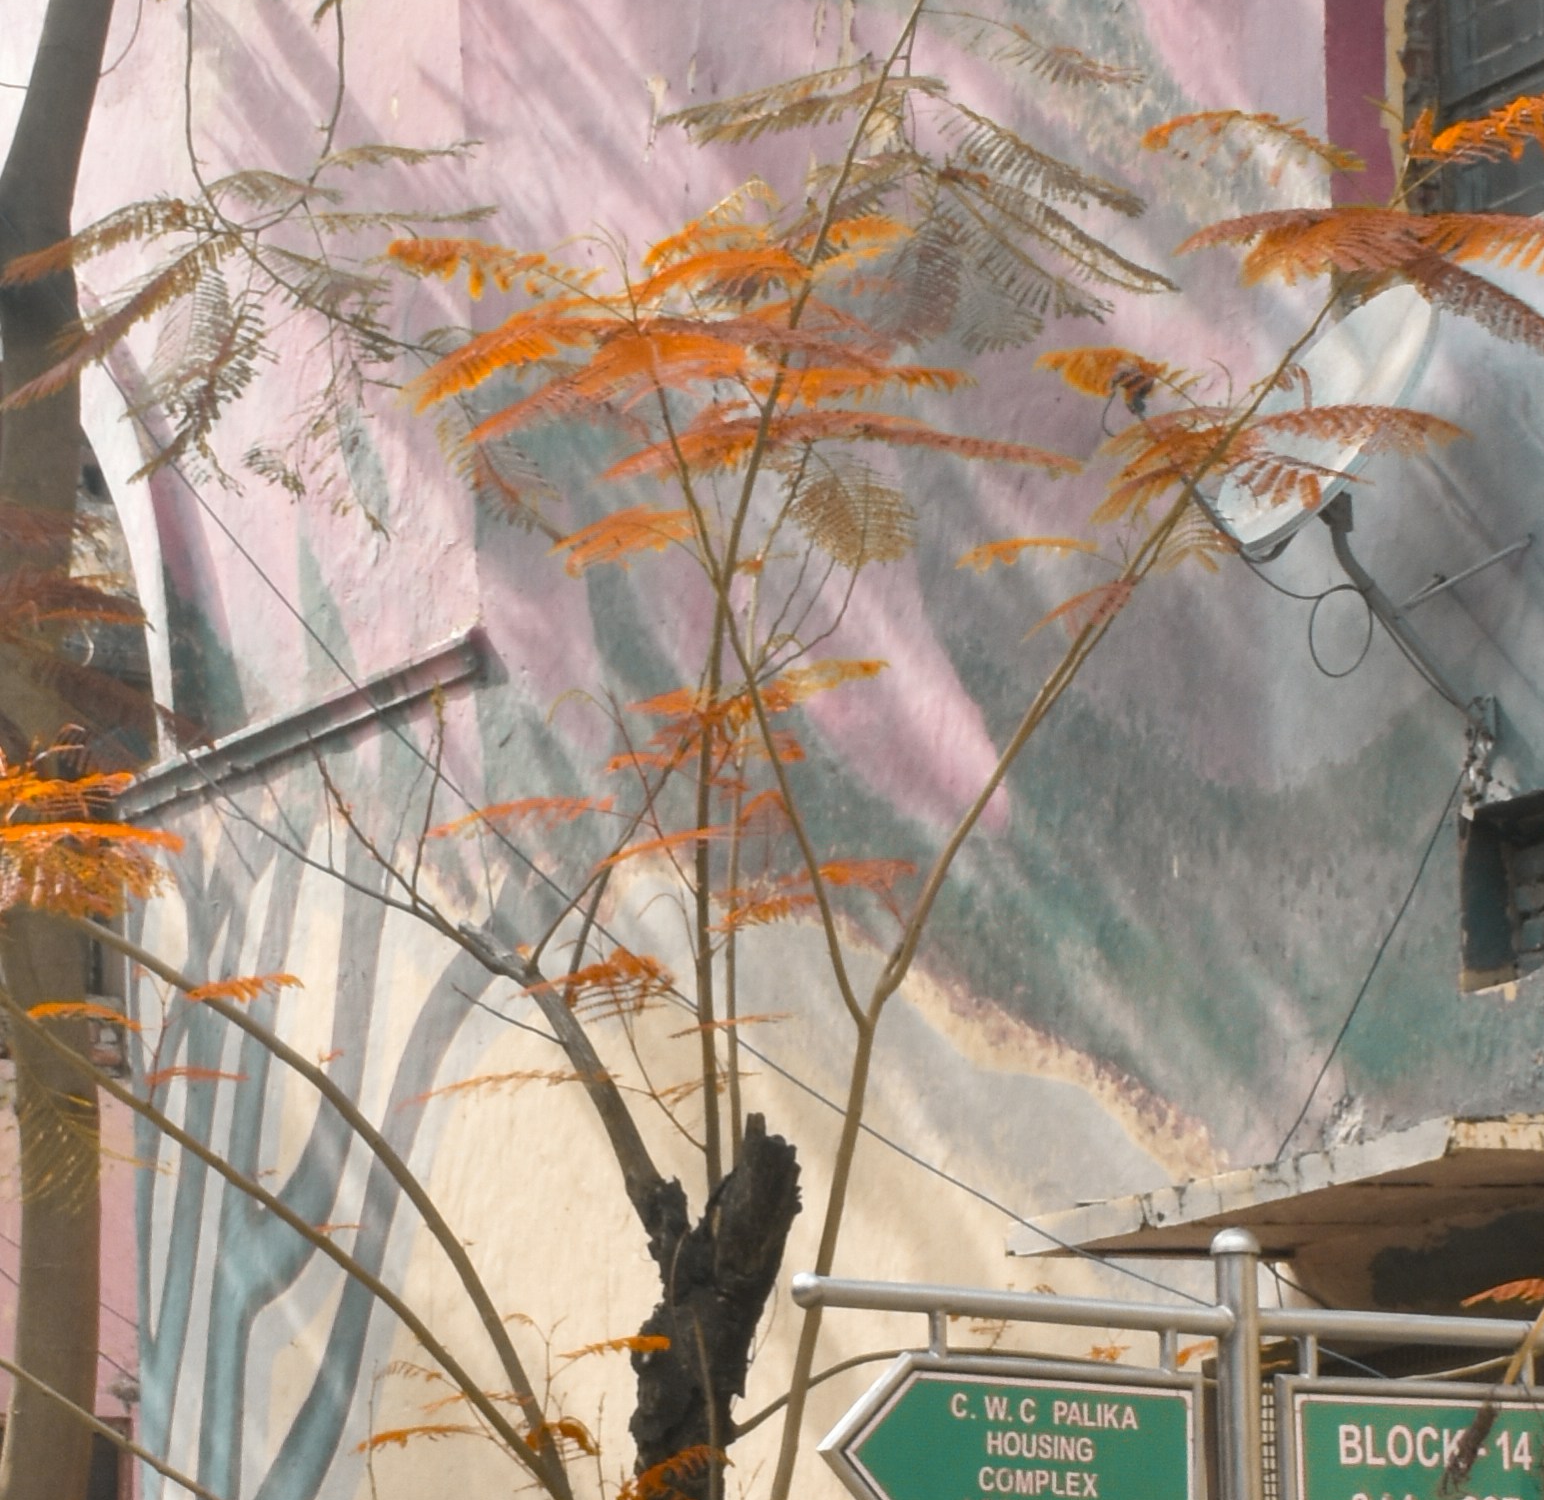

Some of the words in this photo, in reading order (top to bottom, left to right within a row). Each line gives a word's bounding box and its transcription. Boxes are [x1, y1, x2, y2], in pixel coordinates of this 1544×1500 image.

[1053, 1400, 1139, 1430] PALIKA
[987, 1431, 1094, 1462] HOUSING
[1339, 1424, 1466, 1468] BLOCK
[1496, 1430, 1533, 1471] 14
[978, 1466, 1098, 1498] COMPLEX
